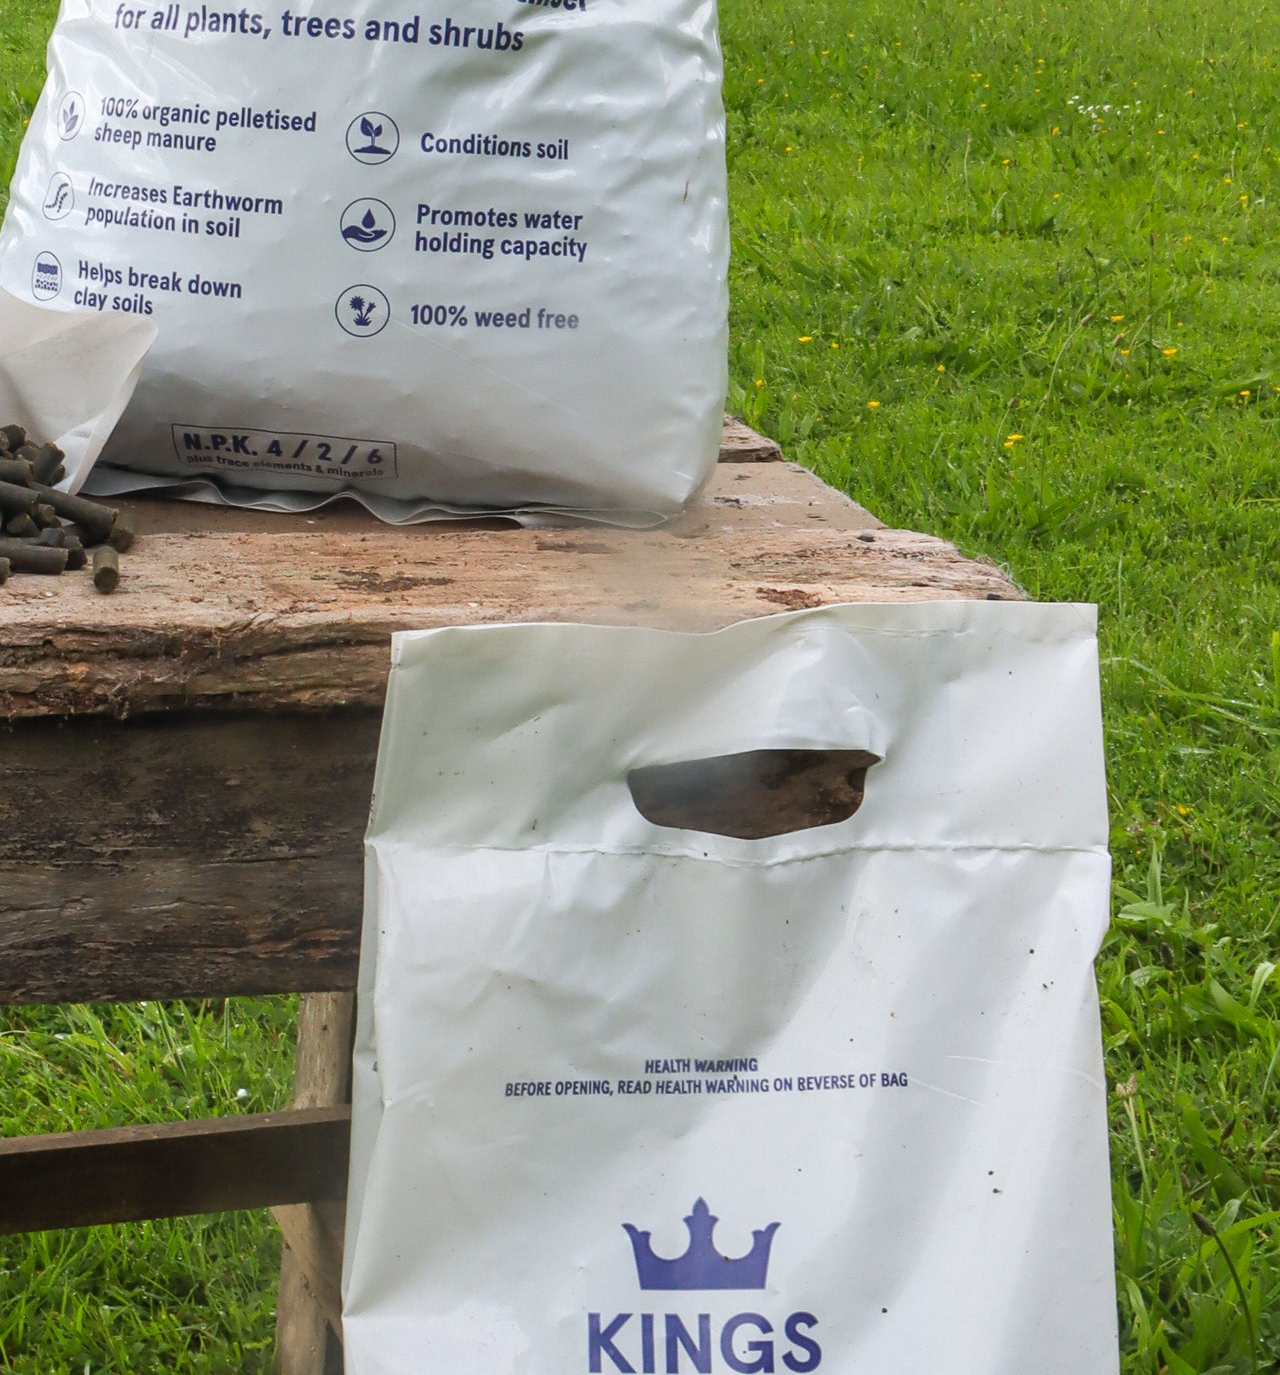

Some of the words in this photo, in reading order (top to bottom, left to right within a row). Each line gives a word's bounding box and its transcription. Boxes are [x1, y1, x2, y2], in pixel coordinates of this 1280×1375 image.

[115, 3, 146, 29] for
[151, 4, 180, 30] all
[184, 5, 272, 39] plants,
[281, 10, 355, 39] trees
[365, 15, 419, 43] and
[428, 21, 524, 52] shrubs
[100, 97, 139, 119] 100%
[142, 103, 210, 126] organic
[215, 107, 317, 132] pelletised
[94, 123, 141, 150] sheep
[146, 132, 217, 152] manure
[420, 132, 531, 158] Conditions
[536, 139, 569, 160] soil
[88, 177, 167, 204] Increases
[173, 186, 283, 214] Earthworm
[84, 206, 175, 231] population
[181, 213, 199, 234] in
[206, 217, 240, 238] soil
[417, 203, 518, 228] Promotes
[524, 211, 583, 230] water
[415, 231, 495, 260] holding
[500, 236, 587, 262] capacity
[78, 259, 122, 287] Helps
[128, 266, 182, 292] break
[188, 273, 242, 299] down
[74, 288, 108, 311] clay
[112, 293, 153, 315] soils
[411, 304, 468, 327] 100%
[475, 307, 530, 328] weed
[537, 308, 579, 329] free
[183, 433, 258, 456] N.P.K.
[267, 439, 283, 457] 4
[317, 442, 332, 461] 2
[367, 448, 383, 464] 6
[217, 455, 250, 467] trace
[644, 1059, 690, 1074] HEALTH
[694, 1058, 758, 1073] WARNING
[505, 1082, 551, 1097] BEFORE
[555, 1081, 614, 1097] OPENING,
[618, 1080, 652, 1095] READ
[655, 1079, 701, 1094] HEALTH
[705, 1078, 769, 1093] WARNING
[773, 1077, 793, 1091] ON
[797, 1074, 855, 1091] REVERSE
[859, 1073, 877, 1088] OF
[881, 1072, 908, 1088] BAG
[588, 1311, 822, 1374] KINGS
